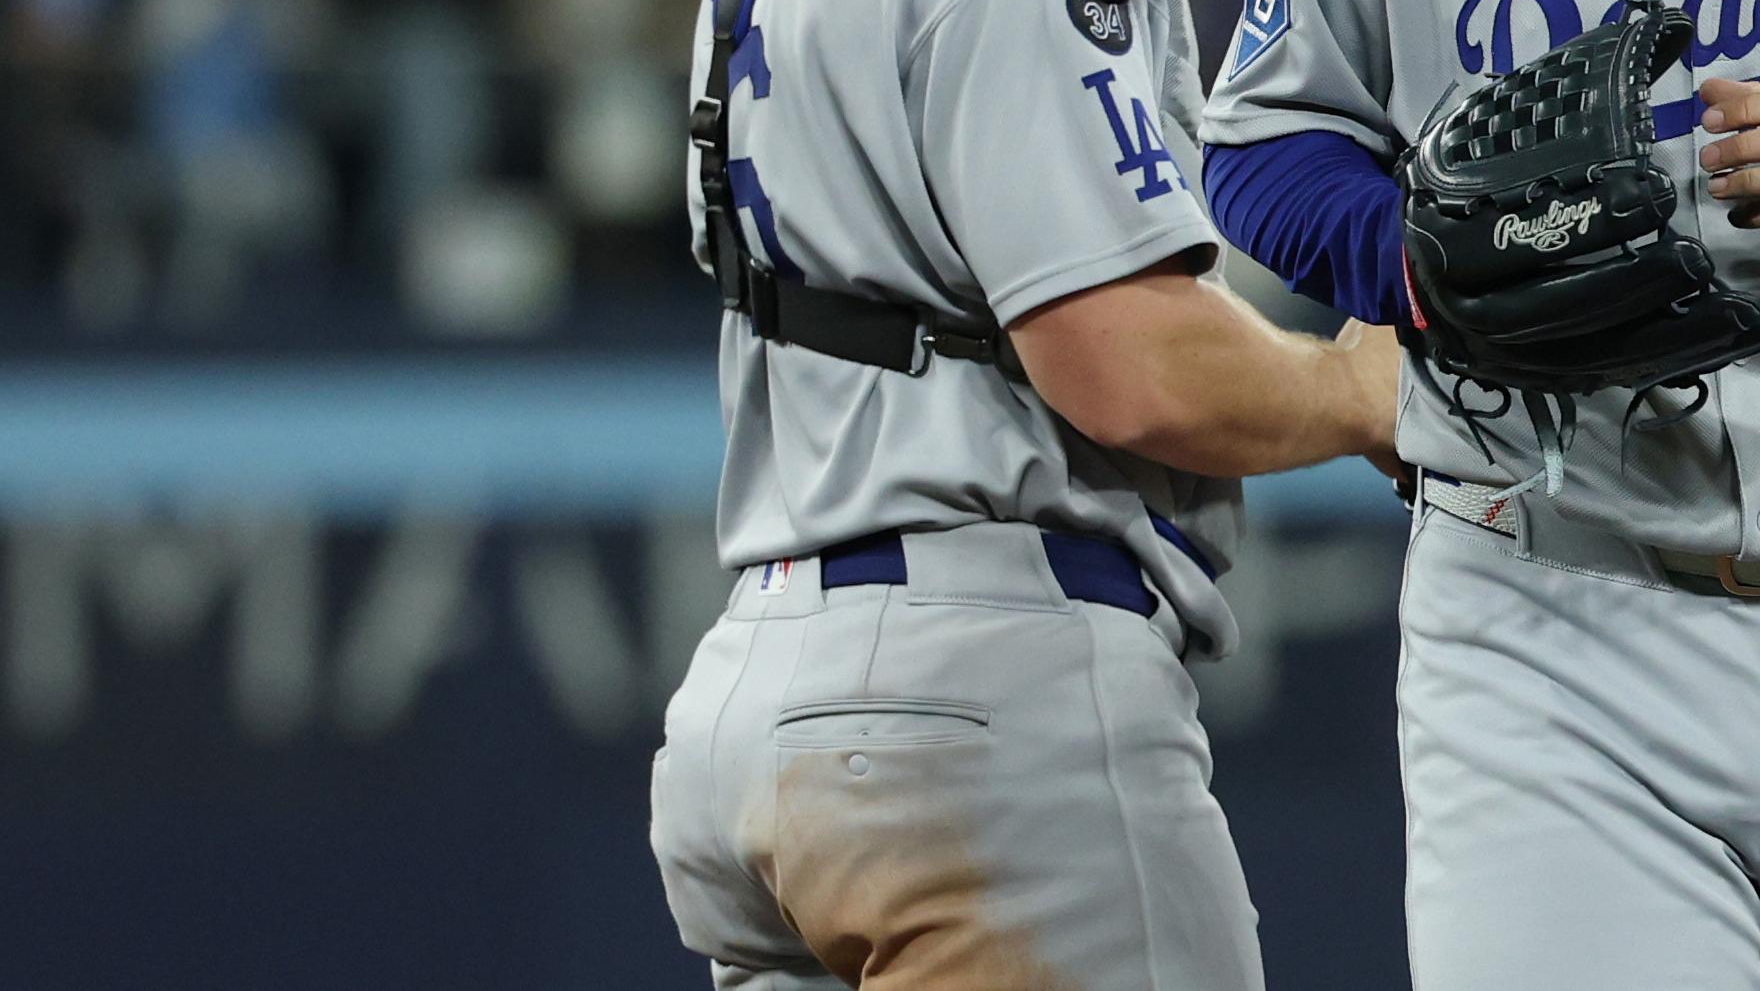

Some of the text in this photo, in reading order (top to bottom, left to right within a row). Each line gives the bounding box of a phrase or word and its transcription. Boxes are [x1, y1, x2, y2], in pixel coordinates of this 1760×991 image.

[1083, 1, 1126, 41] 34
[1081, 67, 1190, 203] LA
[1493, 196, 1602, 250] Rawlings
